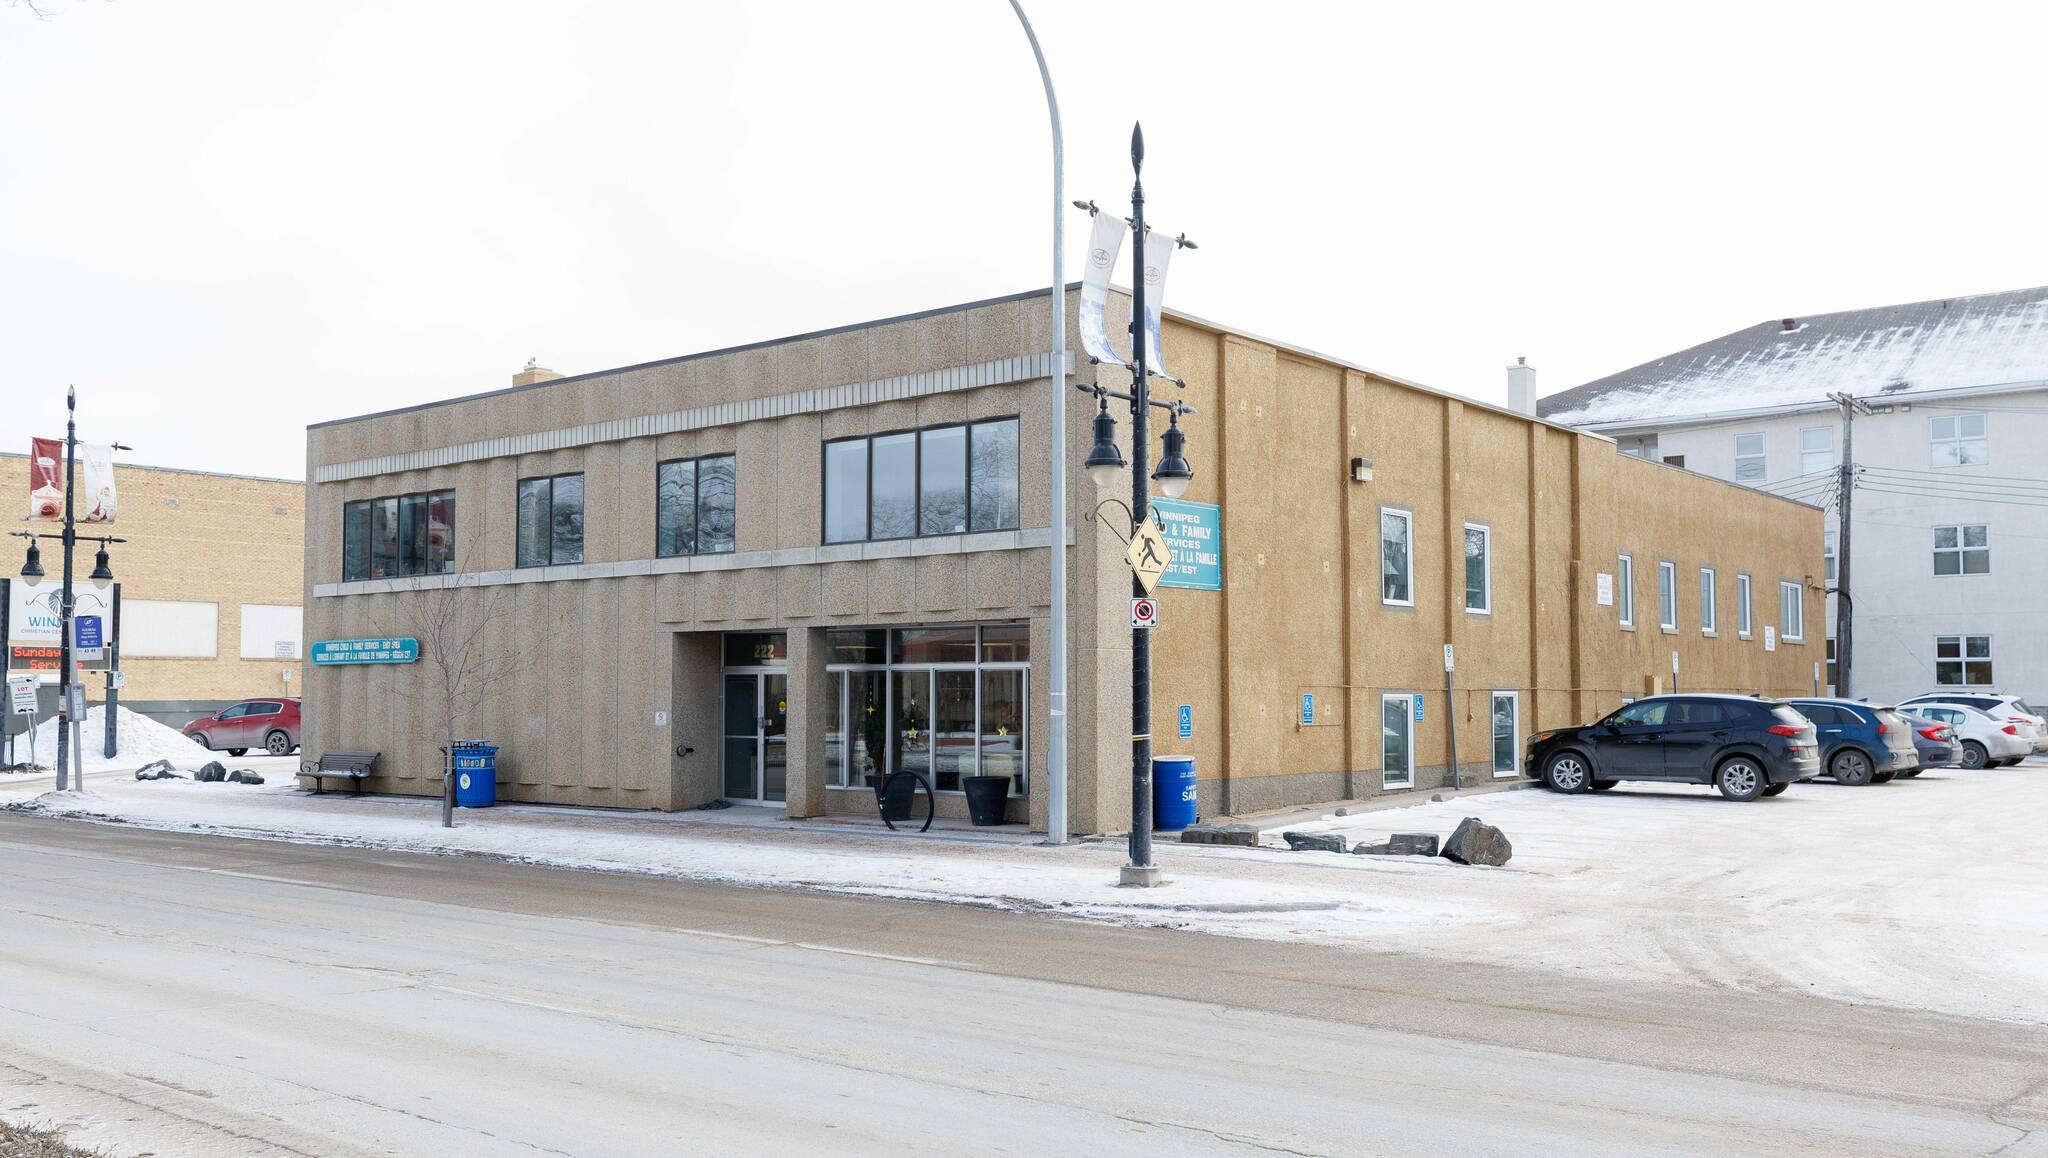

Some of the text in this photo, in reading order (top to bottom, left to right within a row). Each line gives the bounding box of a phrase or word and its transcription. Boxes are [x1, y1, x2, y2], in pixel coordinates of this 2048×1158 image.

[1182, 525, 1212, 540] FAMILY
[1164, 537, 1201, 548] RVICES
[1186, 551, 1194, 563] LA
[1166, 564, 1197, 575] ST/EST
[28, 616, 60, 627] WIN
[753, 644, 774, 658] 222
[29, 659, 84, 669] Serve
